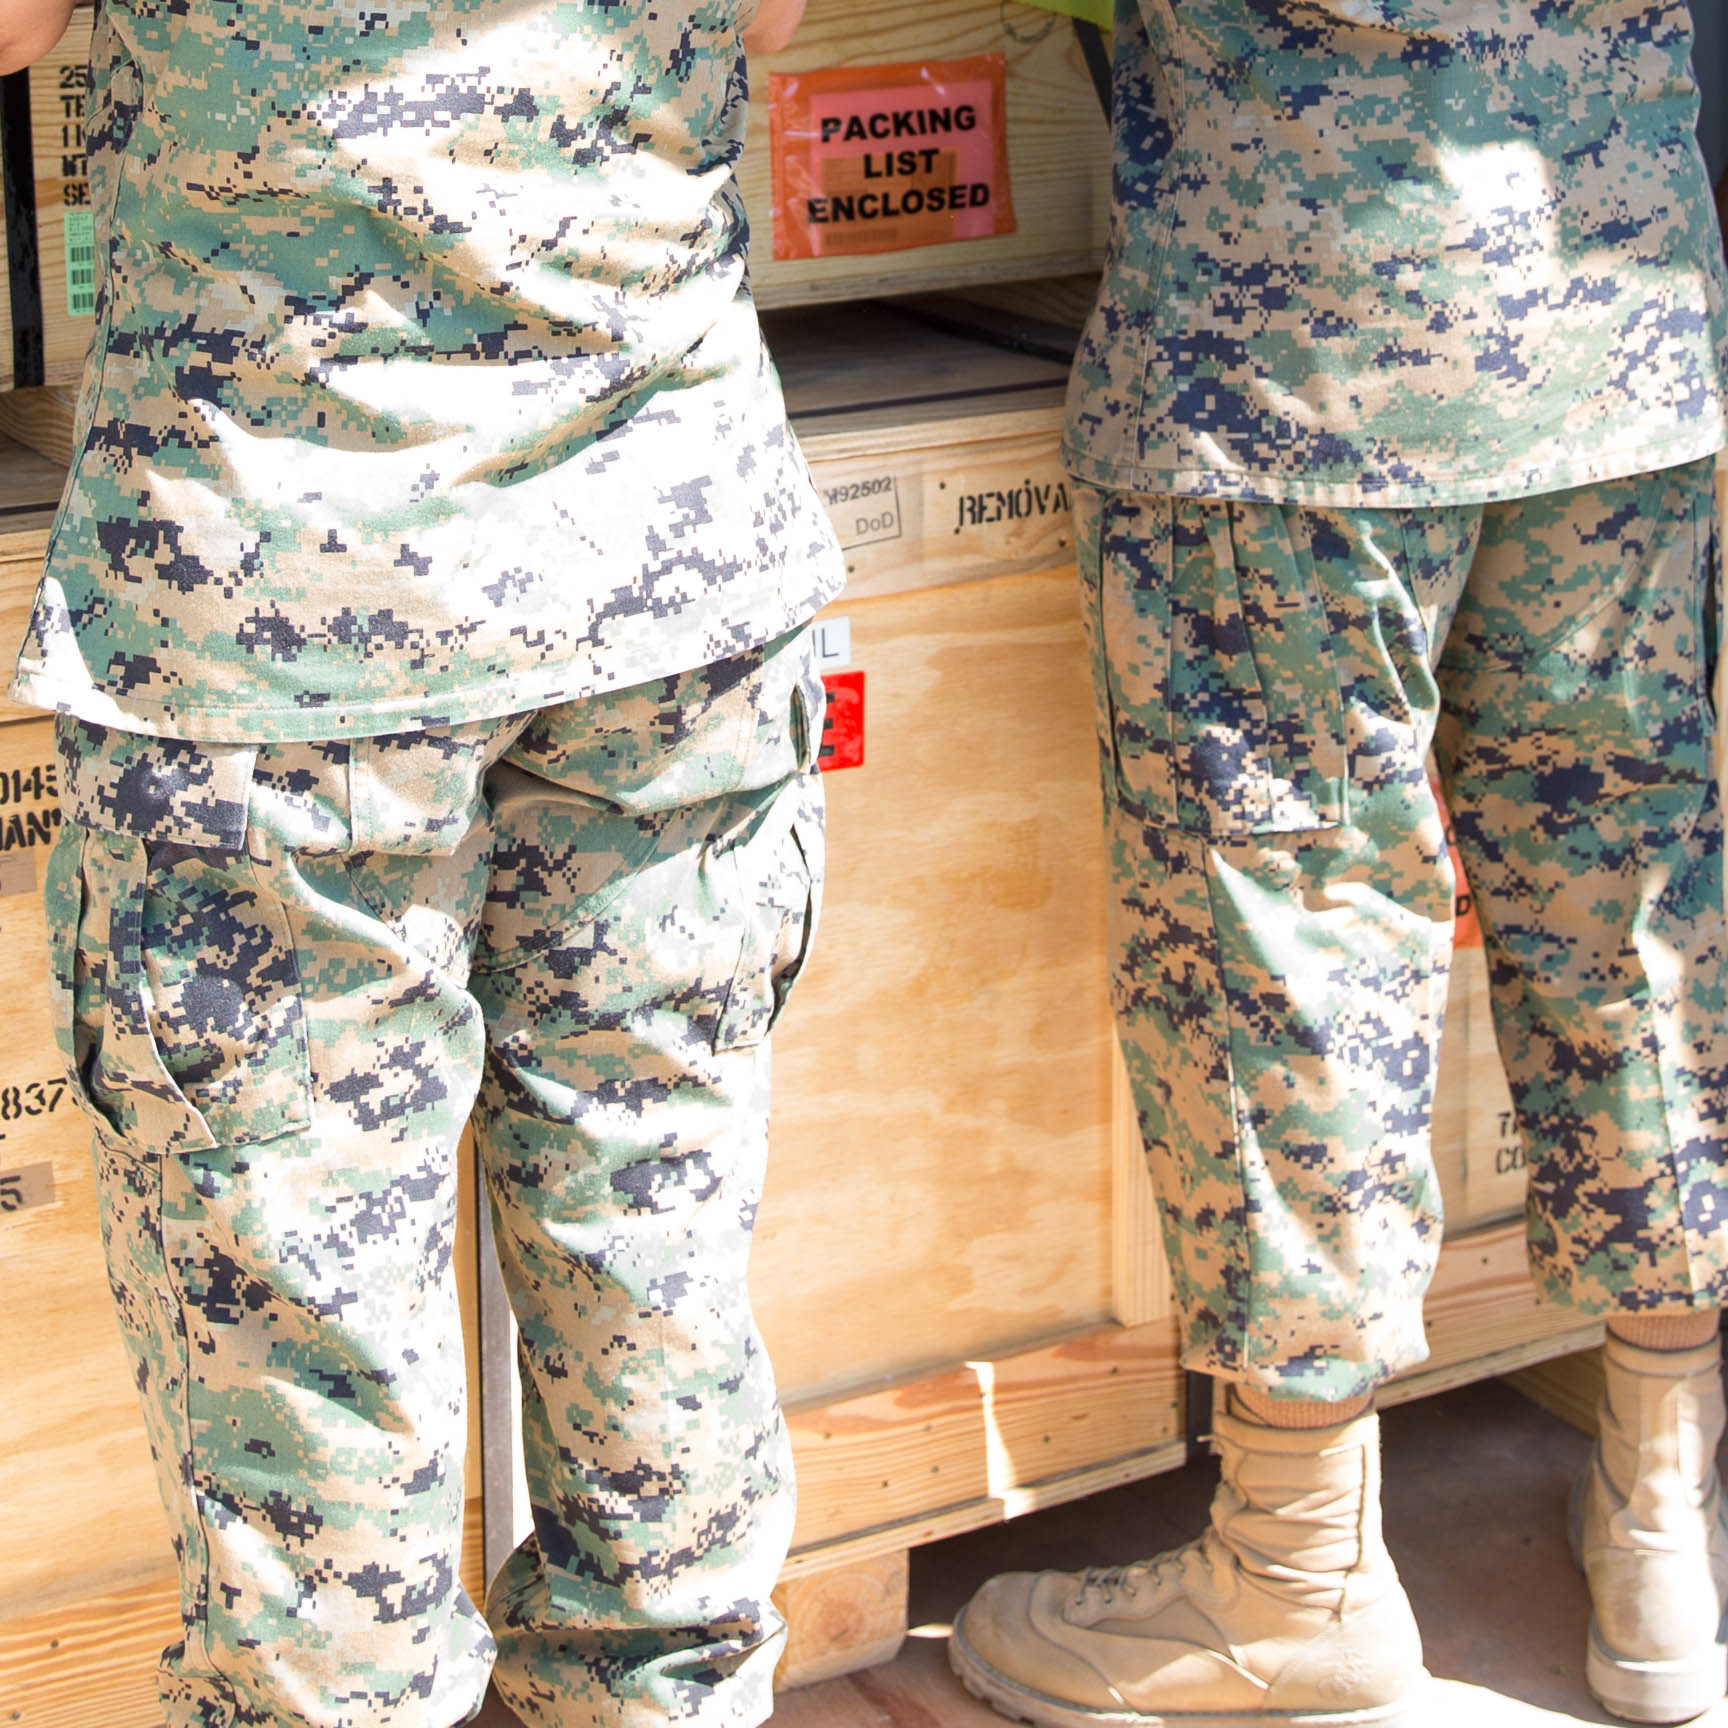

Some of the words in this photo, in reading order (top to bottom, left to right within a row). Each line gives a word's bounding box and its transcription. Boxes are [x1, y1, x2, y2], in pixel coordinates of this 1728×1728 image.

[820, 105, 976, 143] PACKING
[864, 148, 940, 179] LIST
[808, 183, 990, 224] ENCLOSED
[856, 512, 894, 536] DoD
